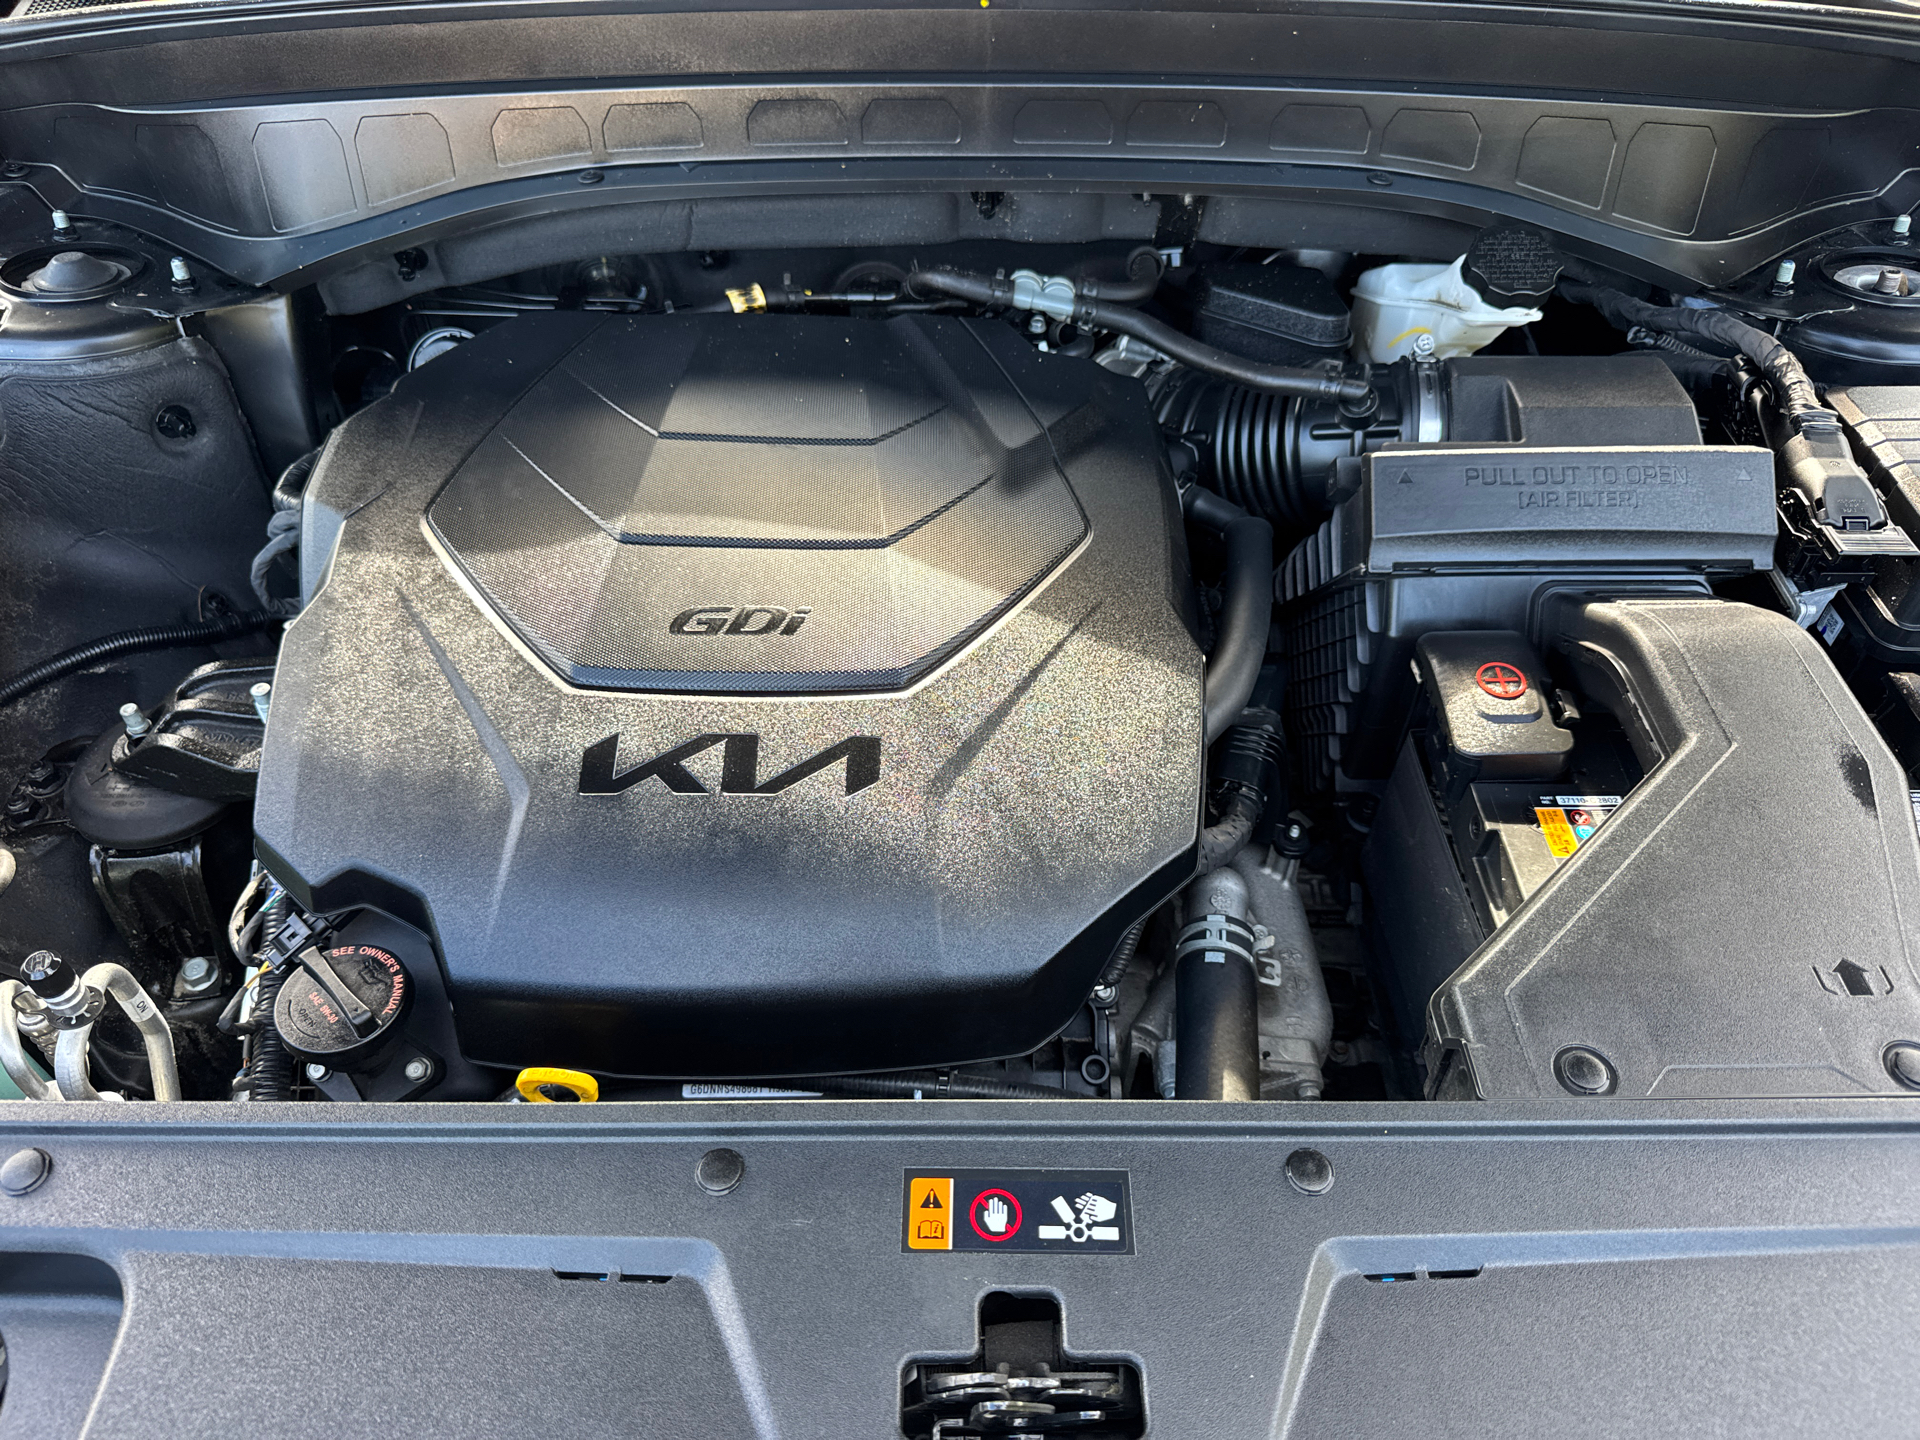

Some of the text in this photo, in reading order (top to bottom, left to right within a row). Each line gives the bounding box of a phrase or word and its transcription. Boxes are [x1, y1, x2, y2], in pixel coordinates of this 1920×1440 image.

[1464, 465, 1689, 486] PULL OUT TO OPEN
[669, 606, 812, 635] GDi
[578, 732, 882, 798] KIA
[332, 946, 403, 1015] SEE OWNER'S MANUAL
[299, 1008, 317, 1028] OPEN
[308, 991, 339, 1024] SAE 5W-30
[559, 1071, 579, 1080] OIL
